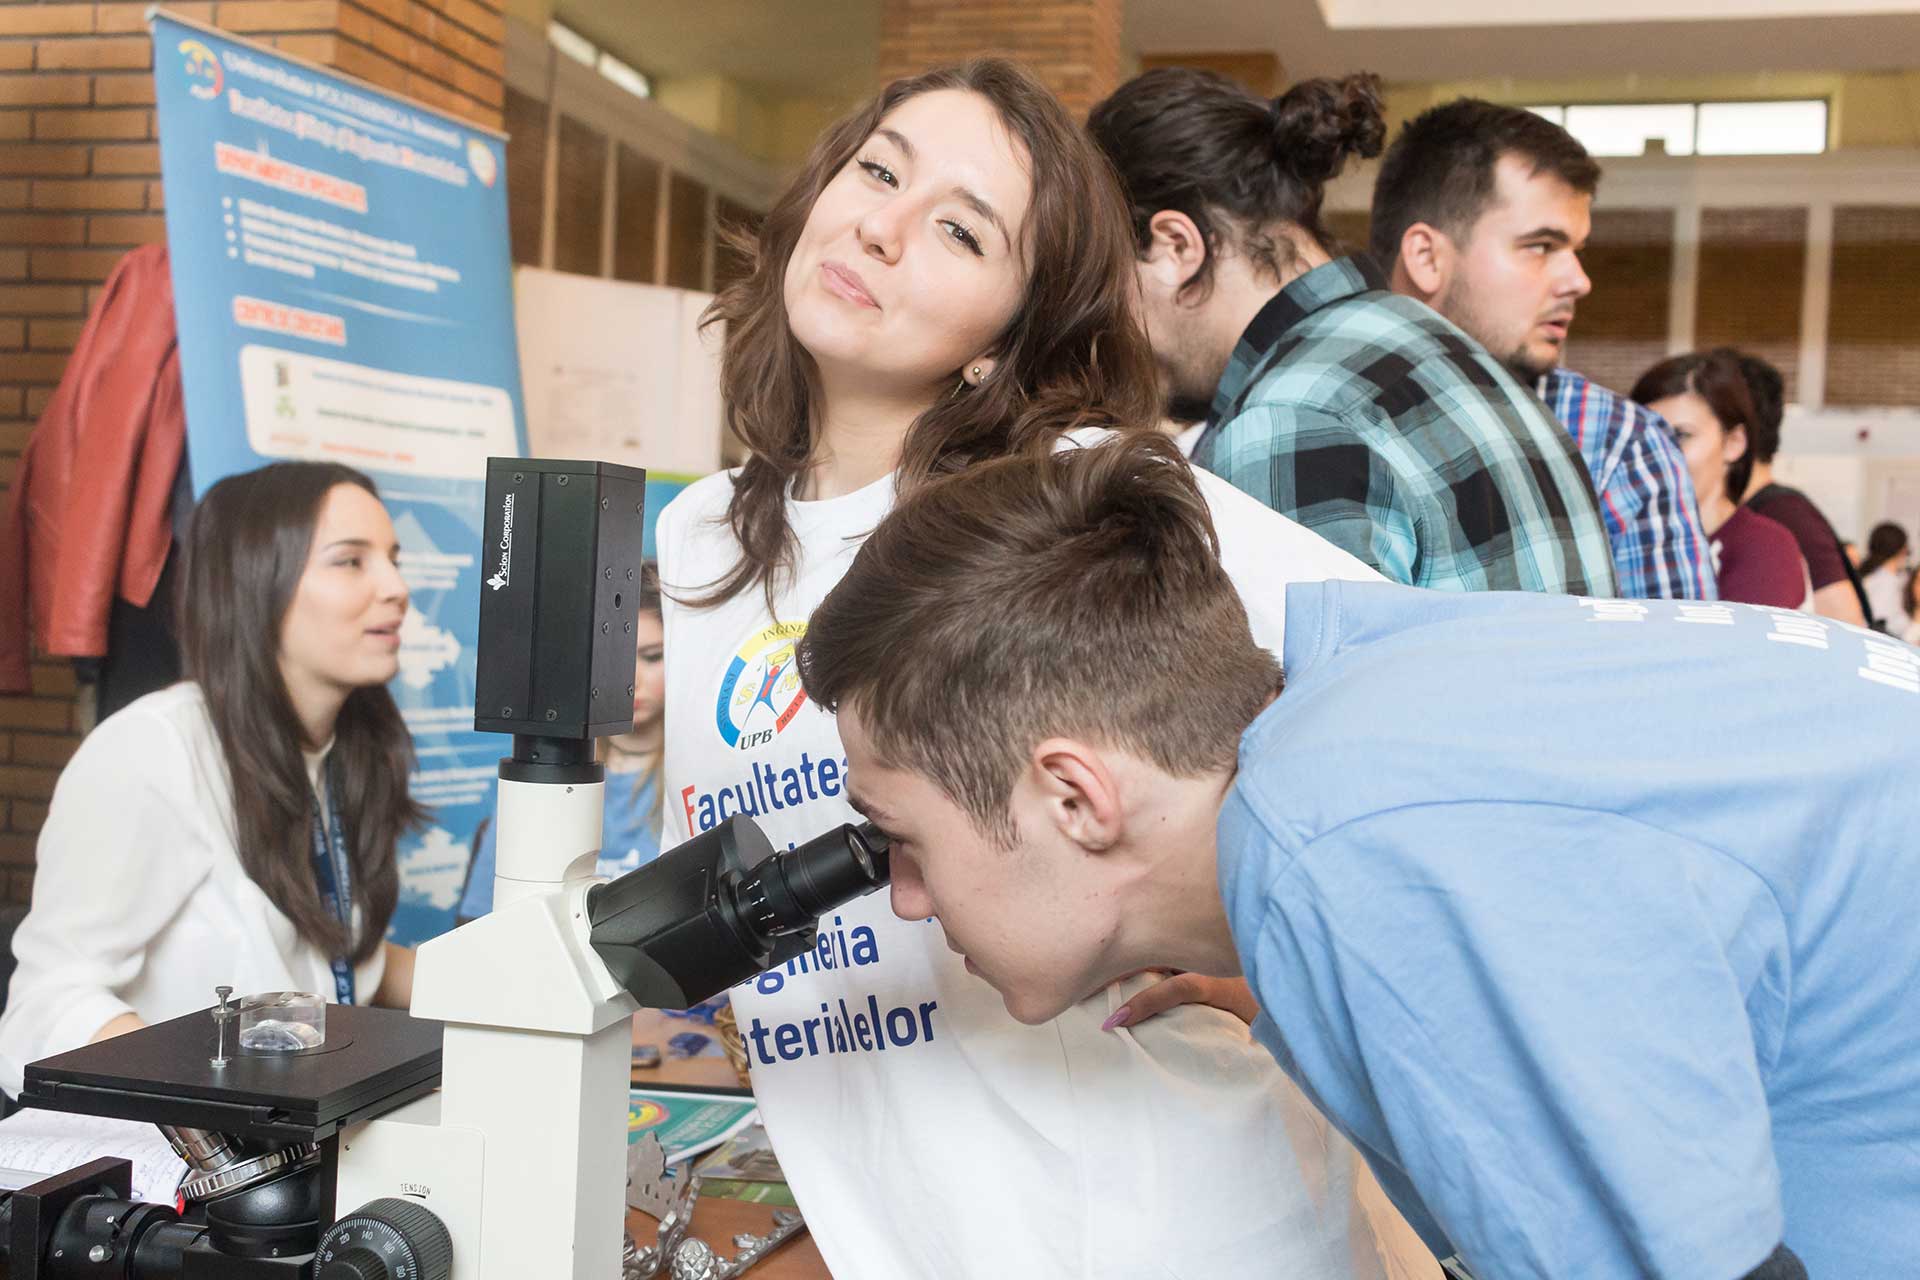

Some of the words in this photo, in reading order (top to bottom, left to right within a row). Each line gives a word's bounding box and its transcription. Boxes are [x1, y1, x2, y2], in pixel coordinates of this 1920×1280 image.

[500, 494, 512, 549] Corporation
[499, 552, 508, 577] Scion
[740, 729, 773, 750] UPB
[741, 995, 937, 1071] terialelor
[400, 1183, 431, 1195] TENSION
[339, 1233, 350, 1244] 120
[361, 1230, 373, 1240] 140
[396, 1265, 406, 1278] 180
